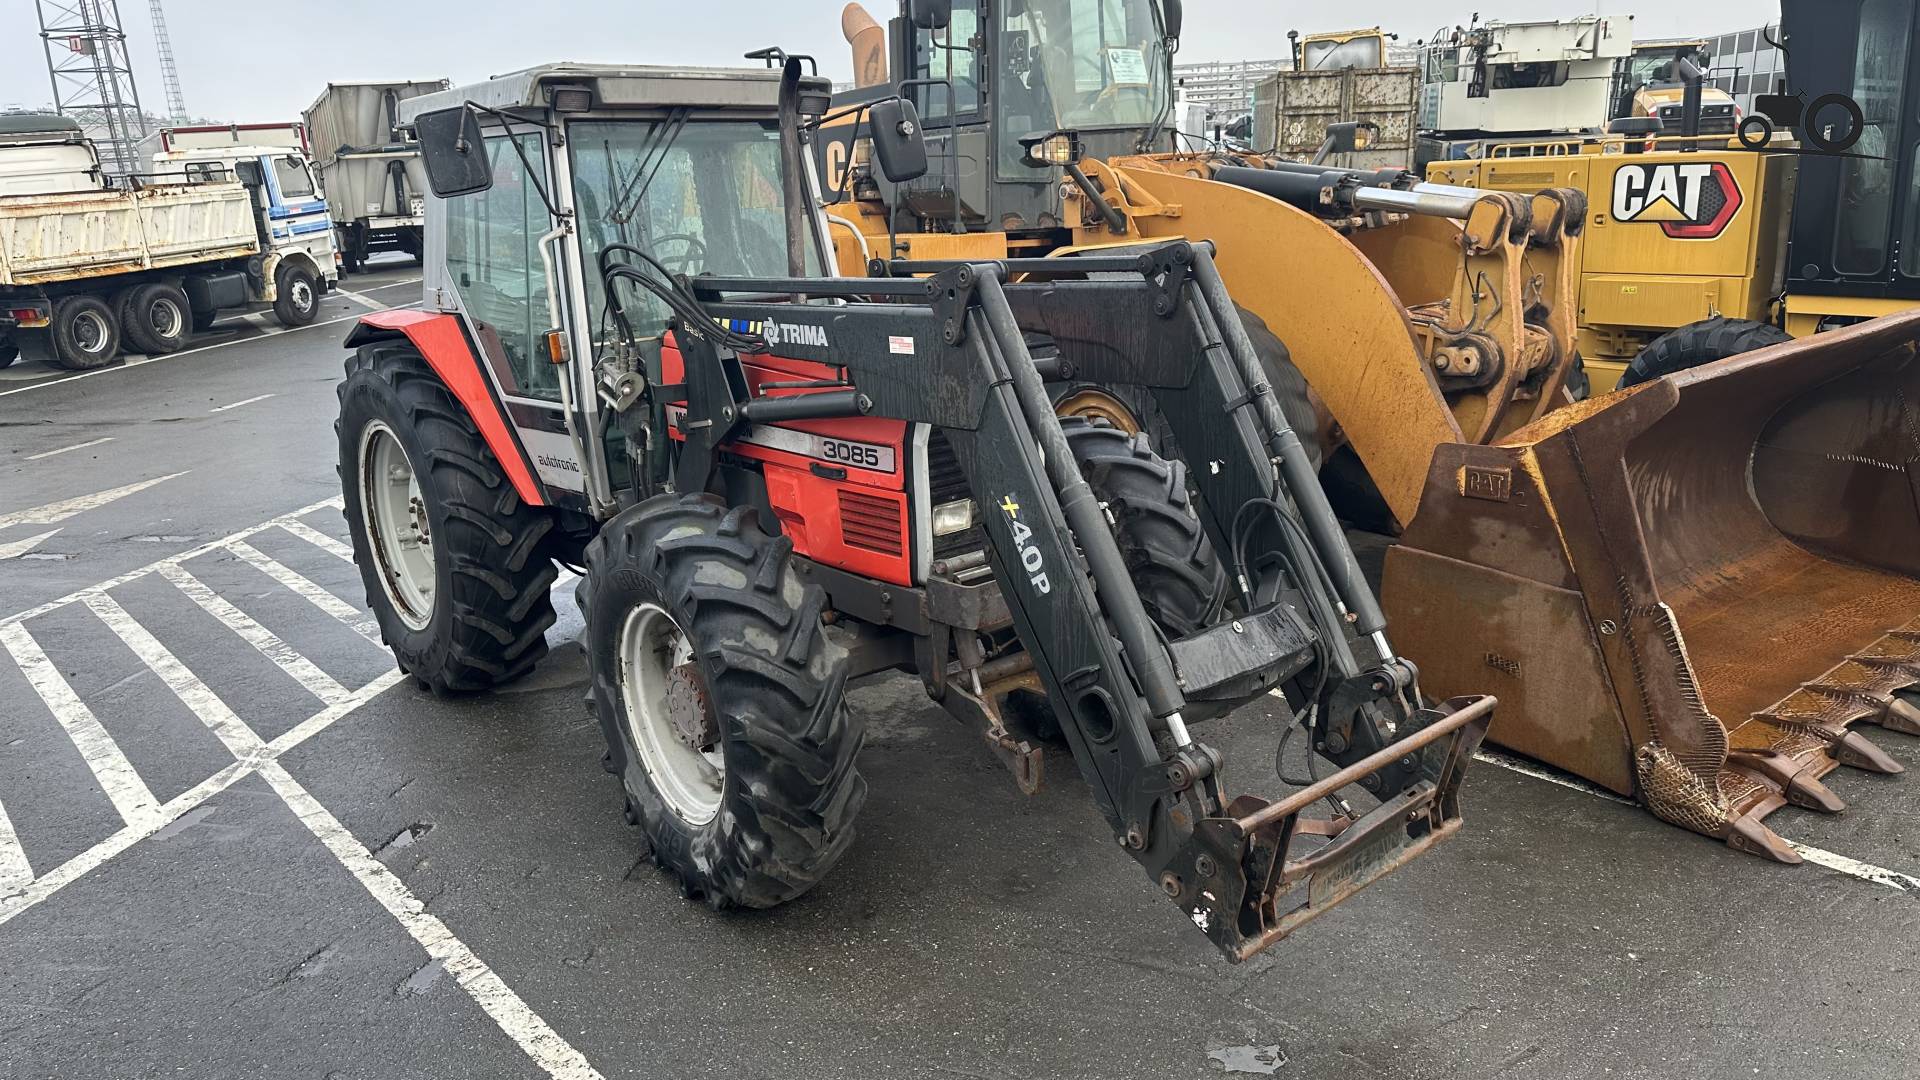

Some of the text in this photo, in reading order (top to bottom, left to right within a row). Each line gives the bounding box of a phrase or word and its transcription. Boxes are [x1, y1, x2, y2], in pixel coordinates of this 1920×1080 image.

[1613, 164, 1712, 221] CAT
[780, 323, 829, 347] TRIMA
[537, 453, 580, 473] autotronic
[823, 440, 879, 467] 3085
